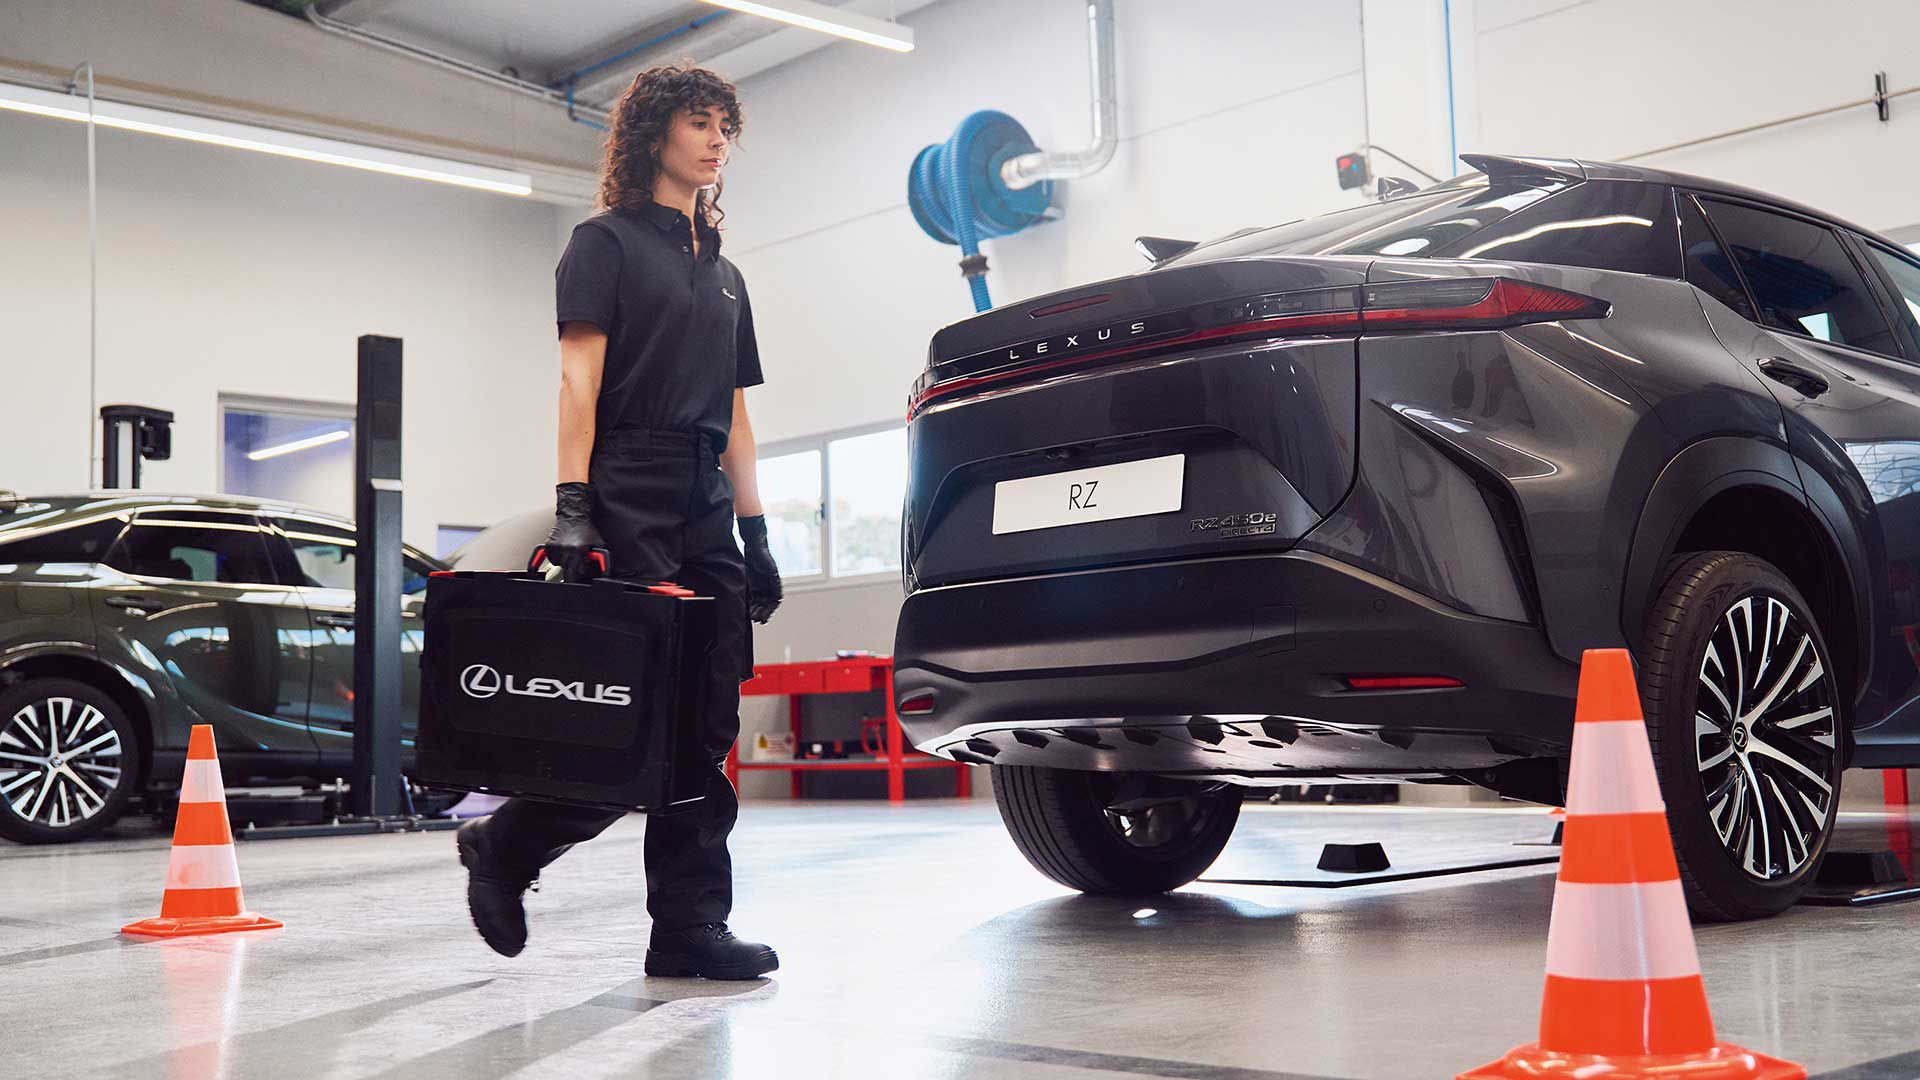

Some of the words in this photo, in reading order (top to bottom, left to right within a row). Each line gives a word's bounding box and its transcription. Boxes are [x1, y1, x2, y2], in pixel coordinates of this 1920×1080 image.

[1009, 322, 1145, 360] LEXUS
[1068, 480, 1099, 510] RZ
[1191, 516, 1219, 532] RZ
[505, 674, 632, 706] LEXUS
